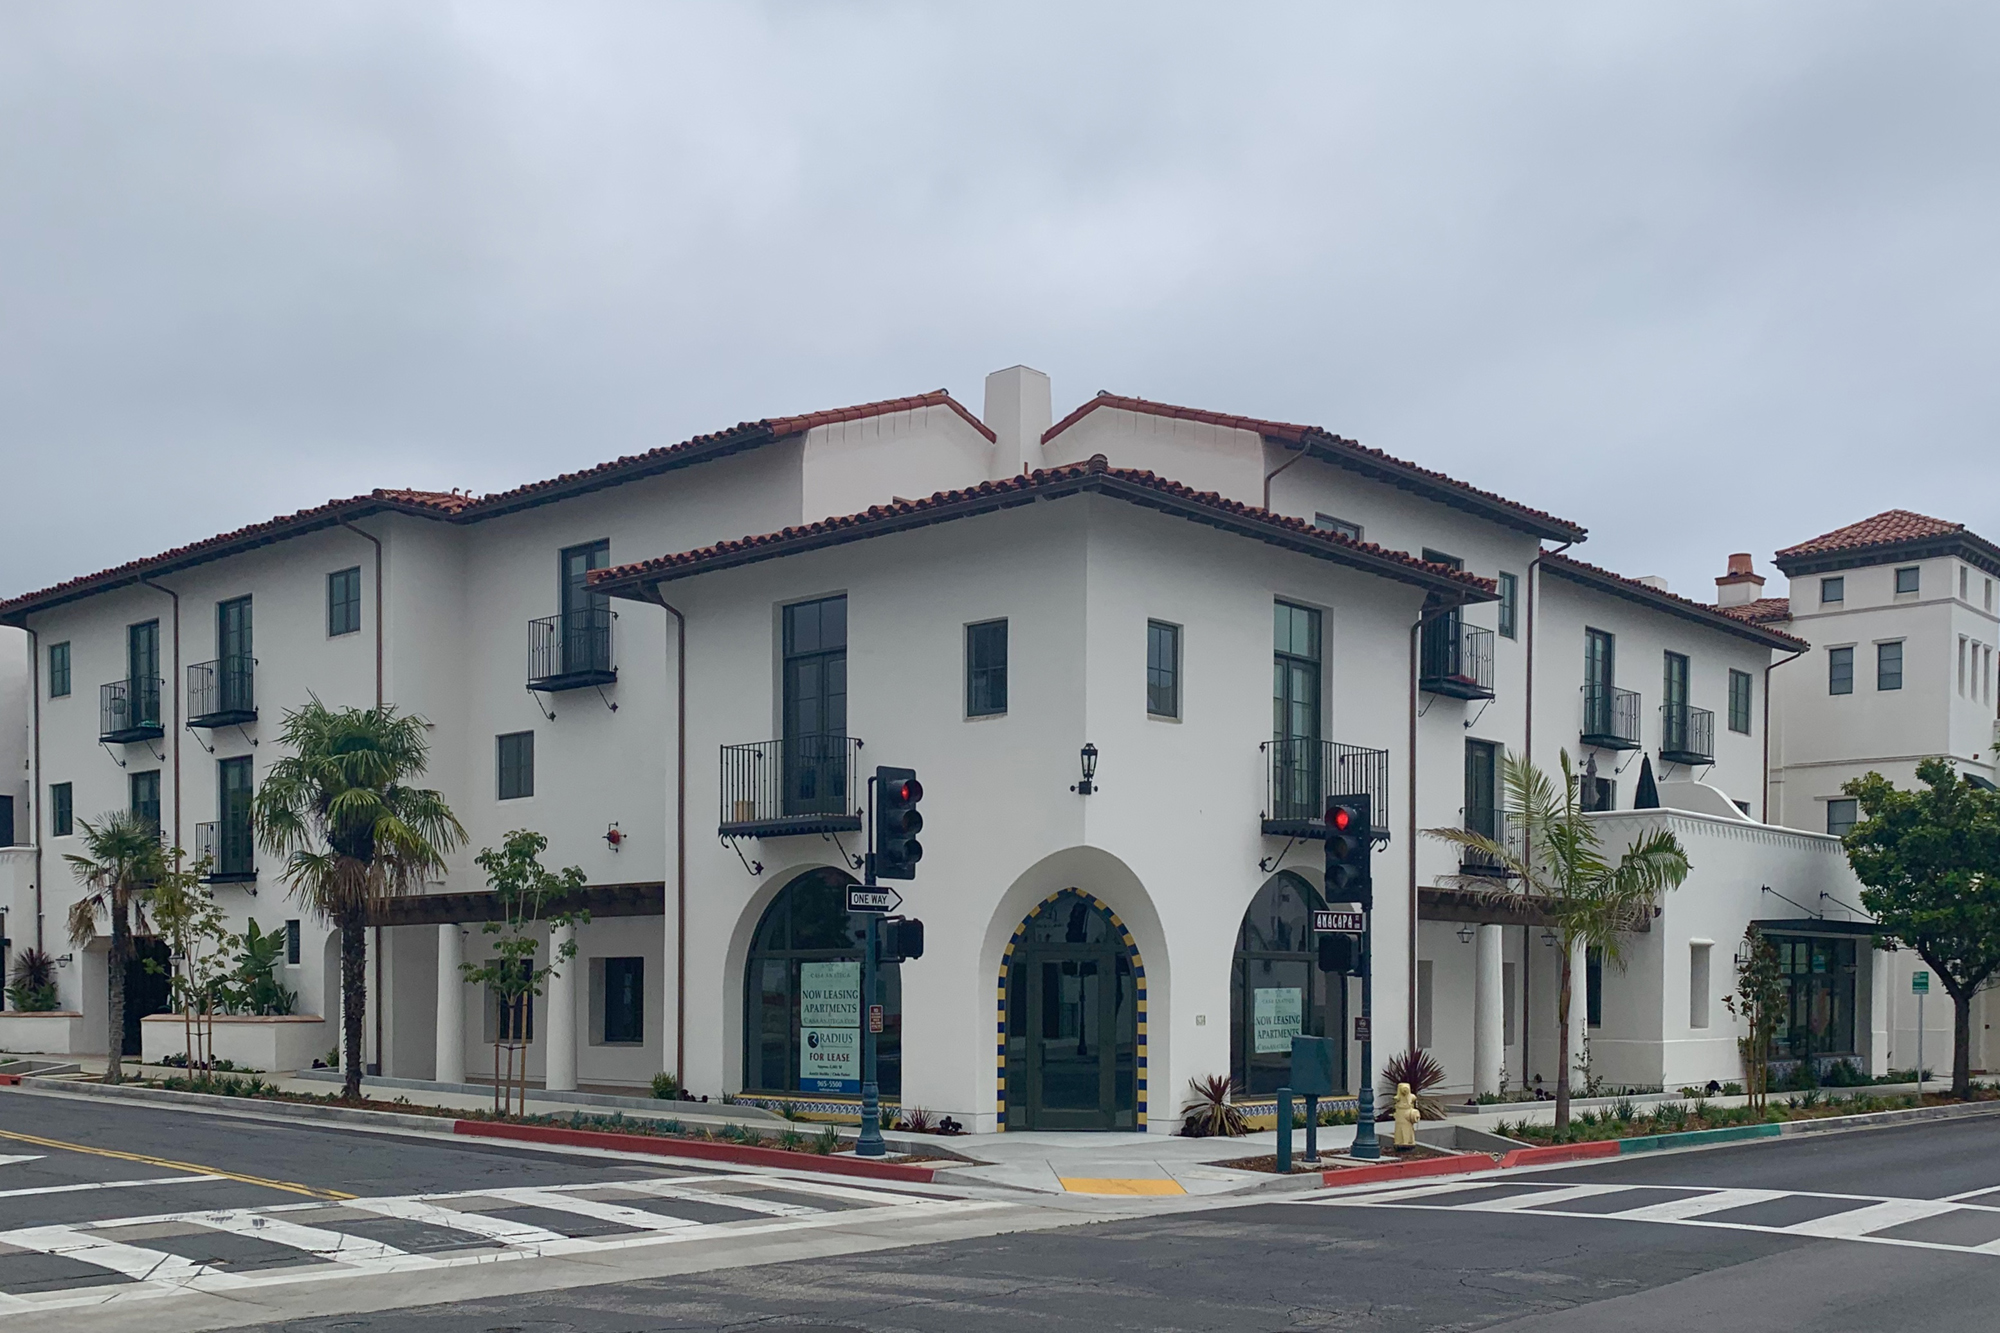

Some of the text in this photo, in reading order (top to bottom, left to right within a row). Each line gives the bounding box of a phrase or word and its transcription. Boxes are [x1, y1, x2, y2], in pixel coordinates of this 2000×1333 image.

[853, 893, 887, 905] ONE WAY
[1316, 914, 1353, 929] ANACAPA
[802, 990, 859, 1000] NOW LEASING
[803, 1004, 857, 1014] APARTMENTS
[1255, 1015, 1301, 1026] NOW LEASING
[820, 1033, 853, 1044] RADIUS
[809, 1053, 850, 1062] FOR LEASE
